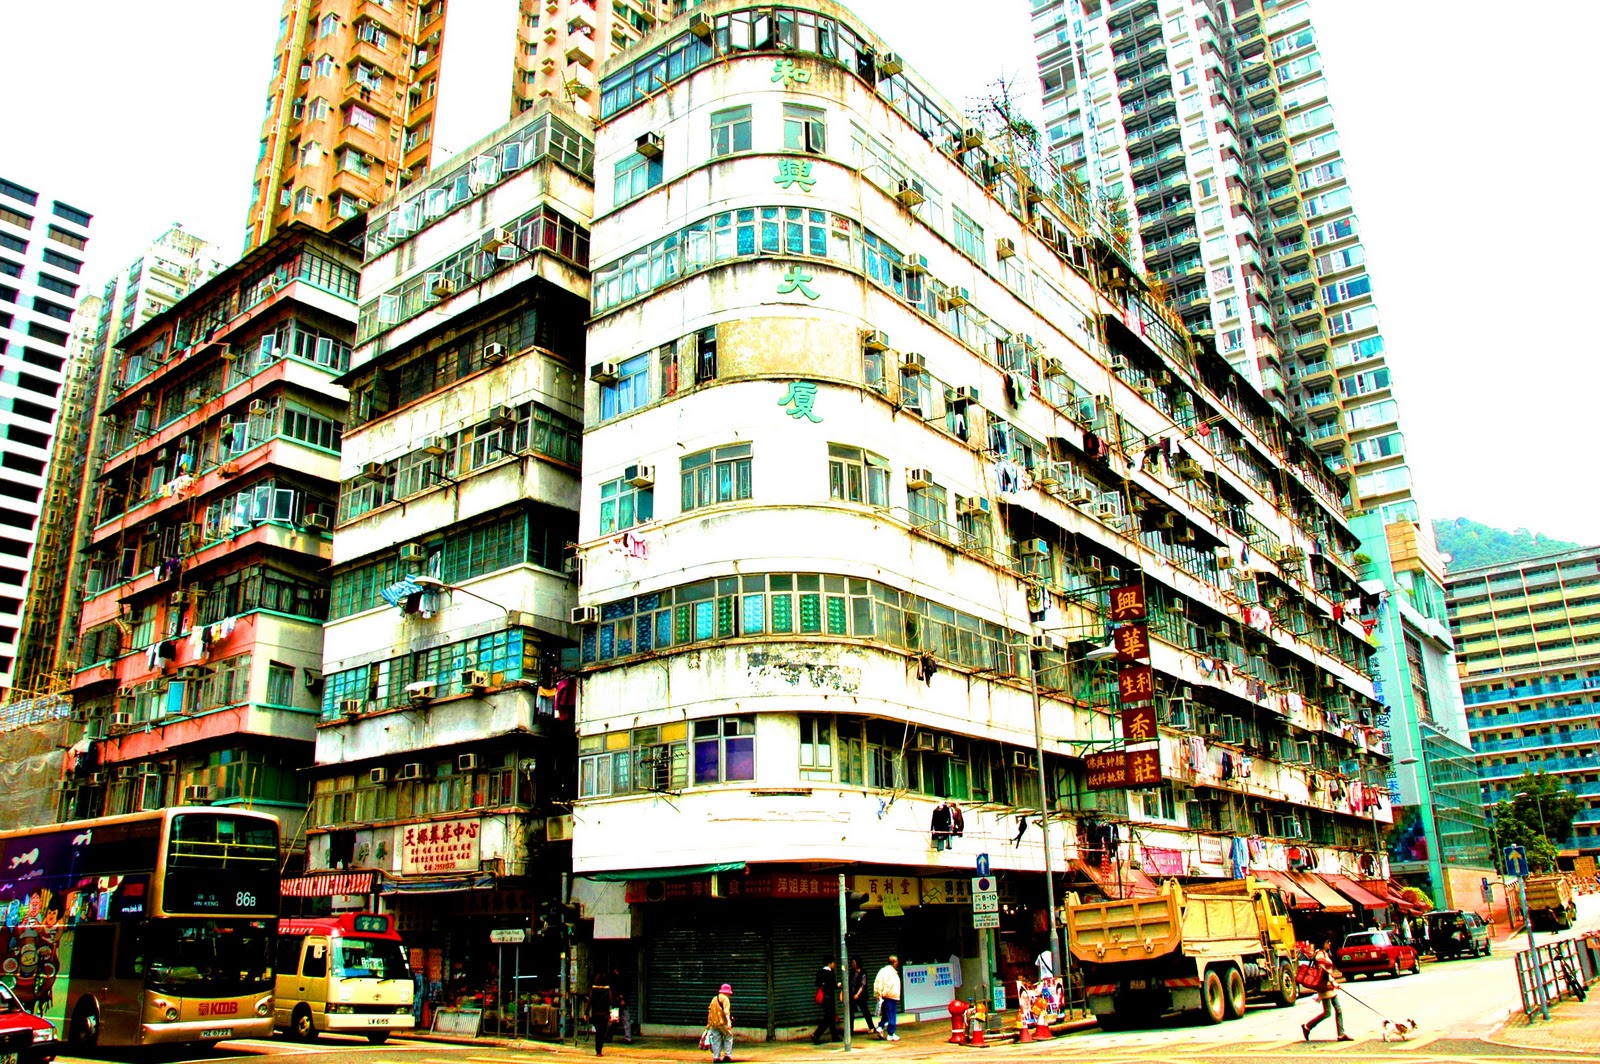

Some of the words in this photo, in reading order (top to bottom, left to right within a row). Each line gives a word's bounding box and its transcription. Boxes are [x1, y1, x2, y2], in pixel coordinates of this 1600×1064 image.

[777, 877, 819, 894] 萍姐美食
[868, 879, 910, 895] 百利堂
[235, 891, 256, 907] 86B
[210, 1001, 238, 1015] KMB
